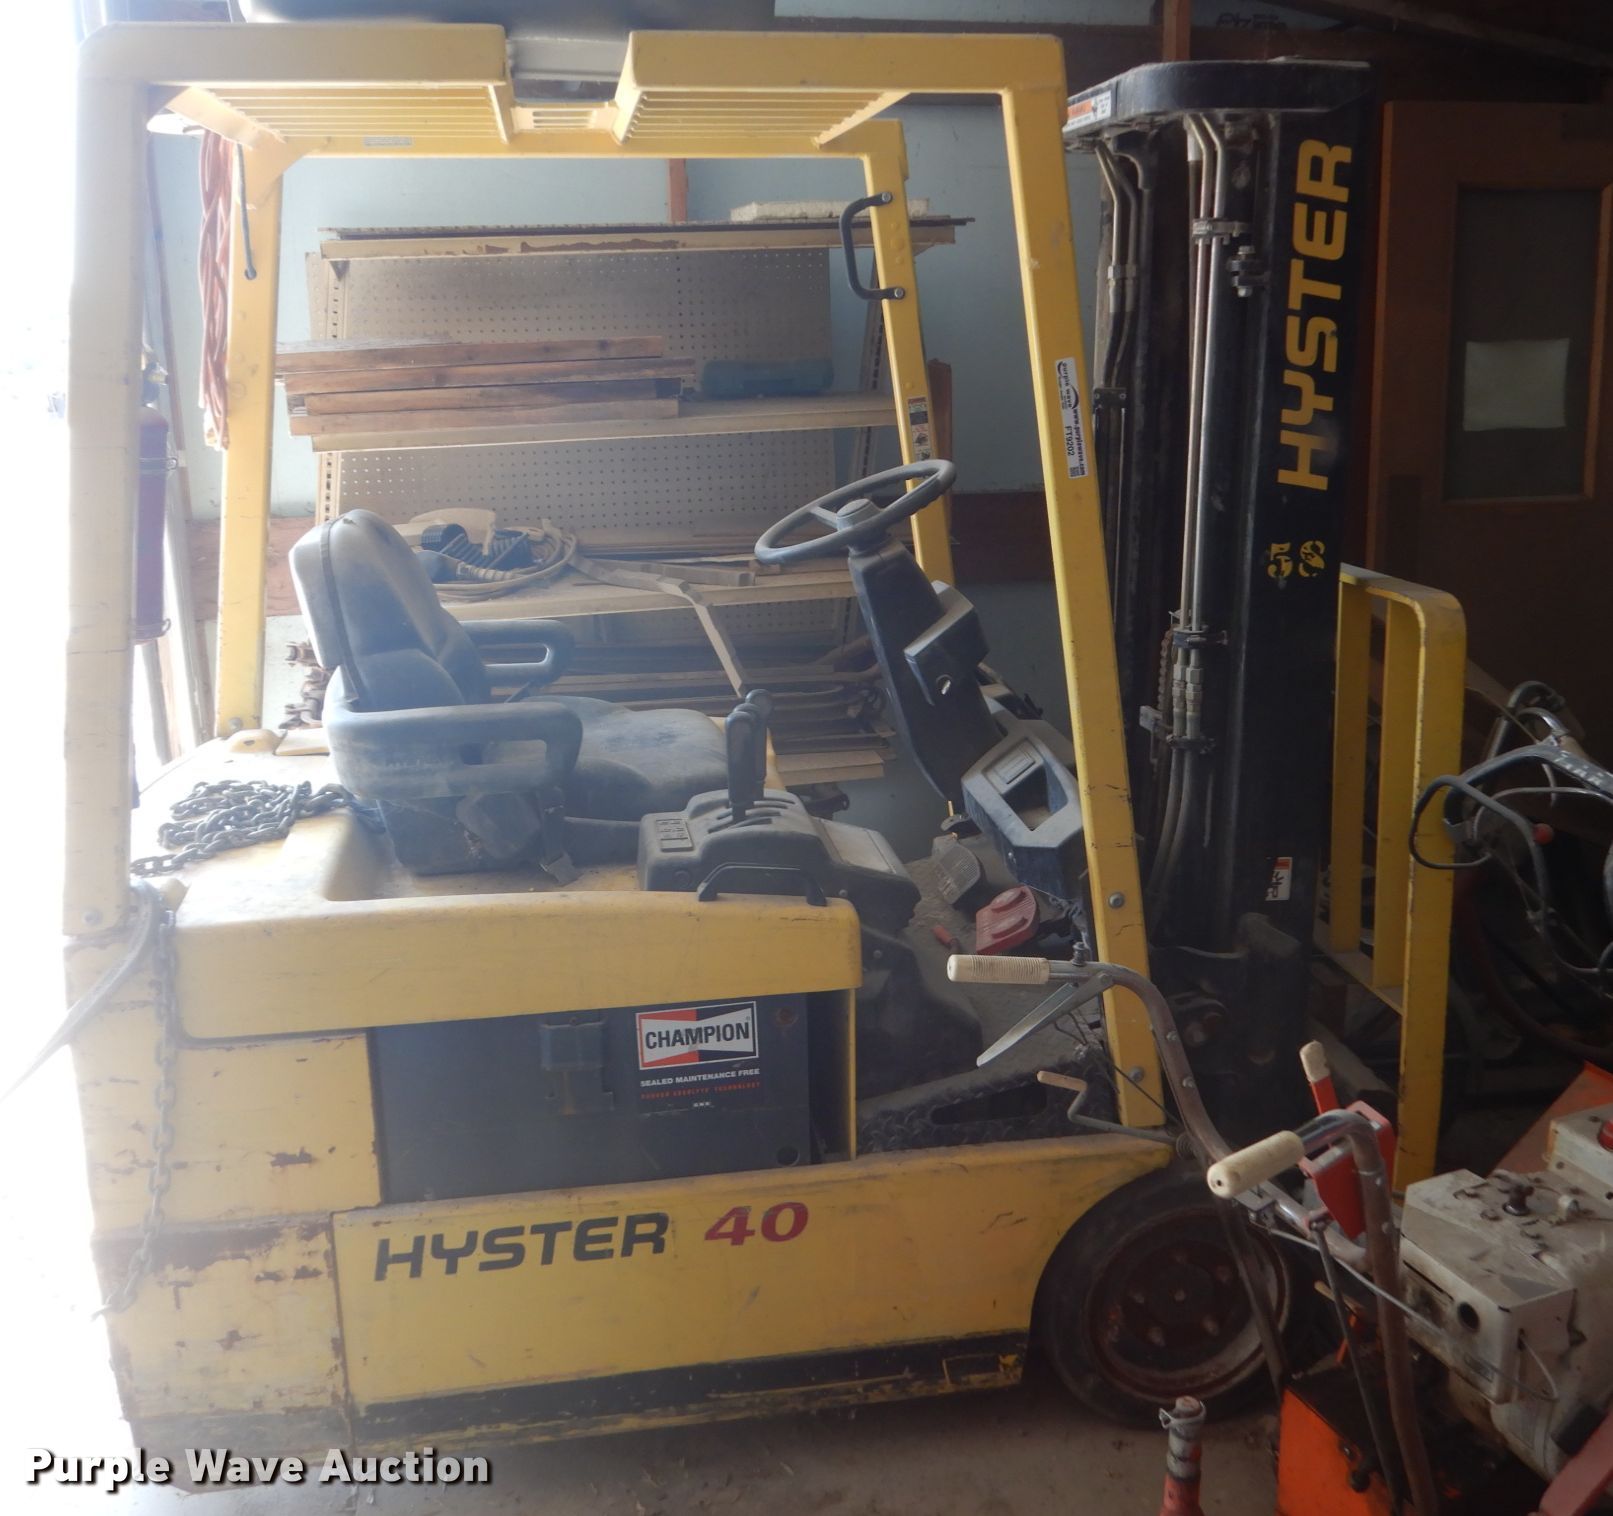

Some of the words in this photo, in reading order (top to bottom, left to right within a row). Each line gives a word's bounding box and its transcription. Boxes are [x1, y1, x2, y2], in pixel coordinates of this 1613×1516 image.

[1277, 138, 1352, 491] HYSTER
[1064, 426, 1075, 456] FT9202
[645, 1021, 750, 1050] CHAMPION
[640, 1077, 673, 1087] SEALED
[675, 1070, 736, 1084] MAINTENANCE
[738, 1067, 760, 1078] FREE
[374, 1211, 670, 1282] HYSTER
[704, 1201, 809, 1247] 40
